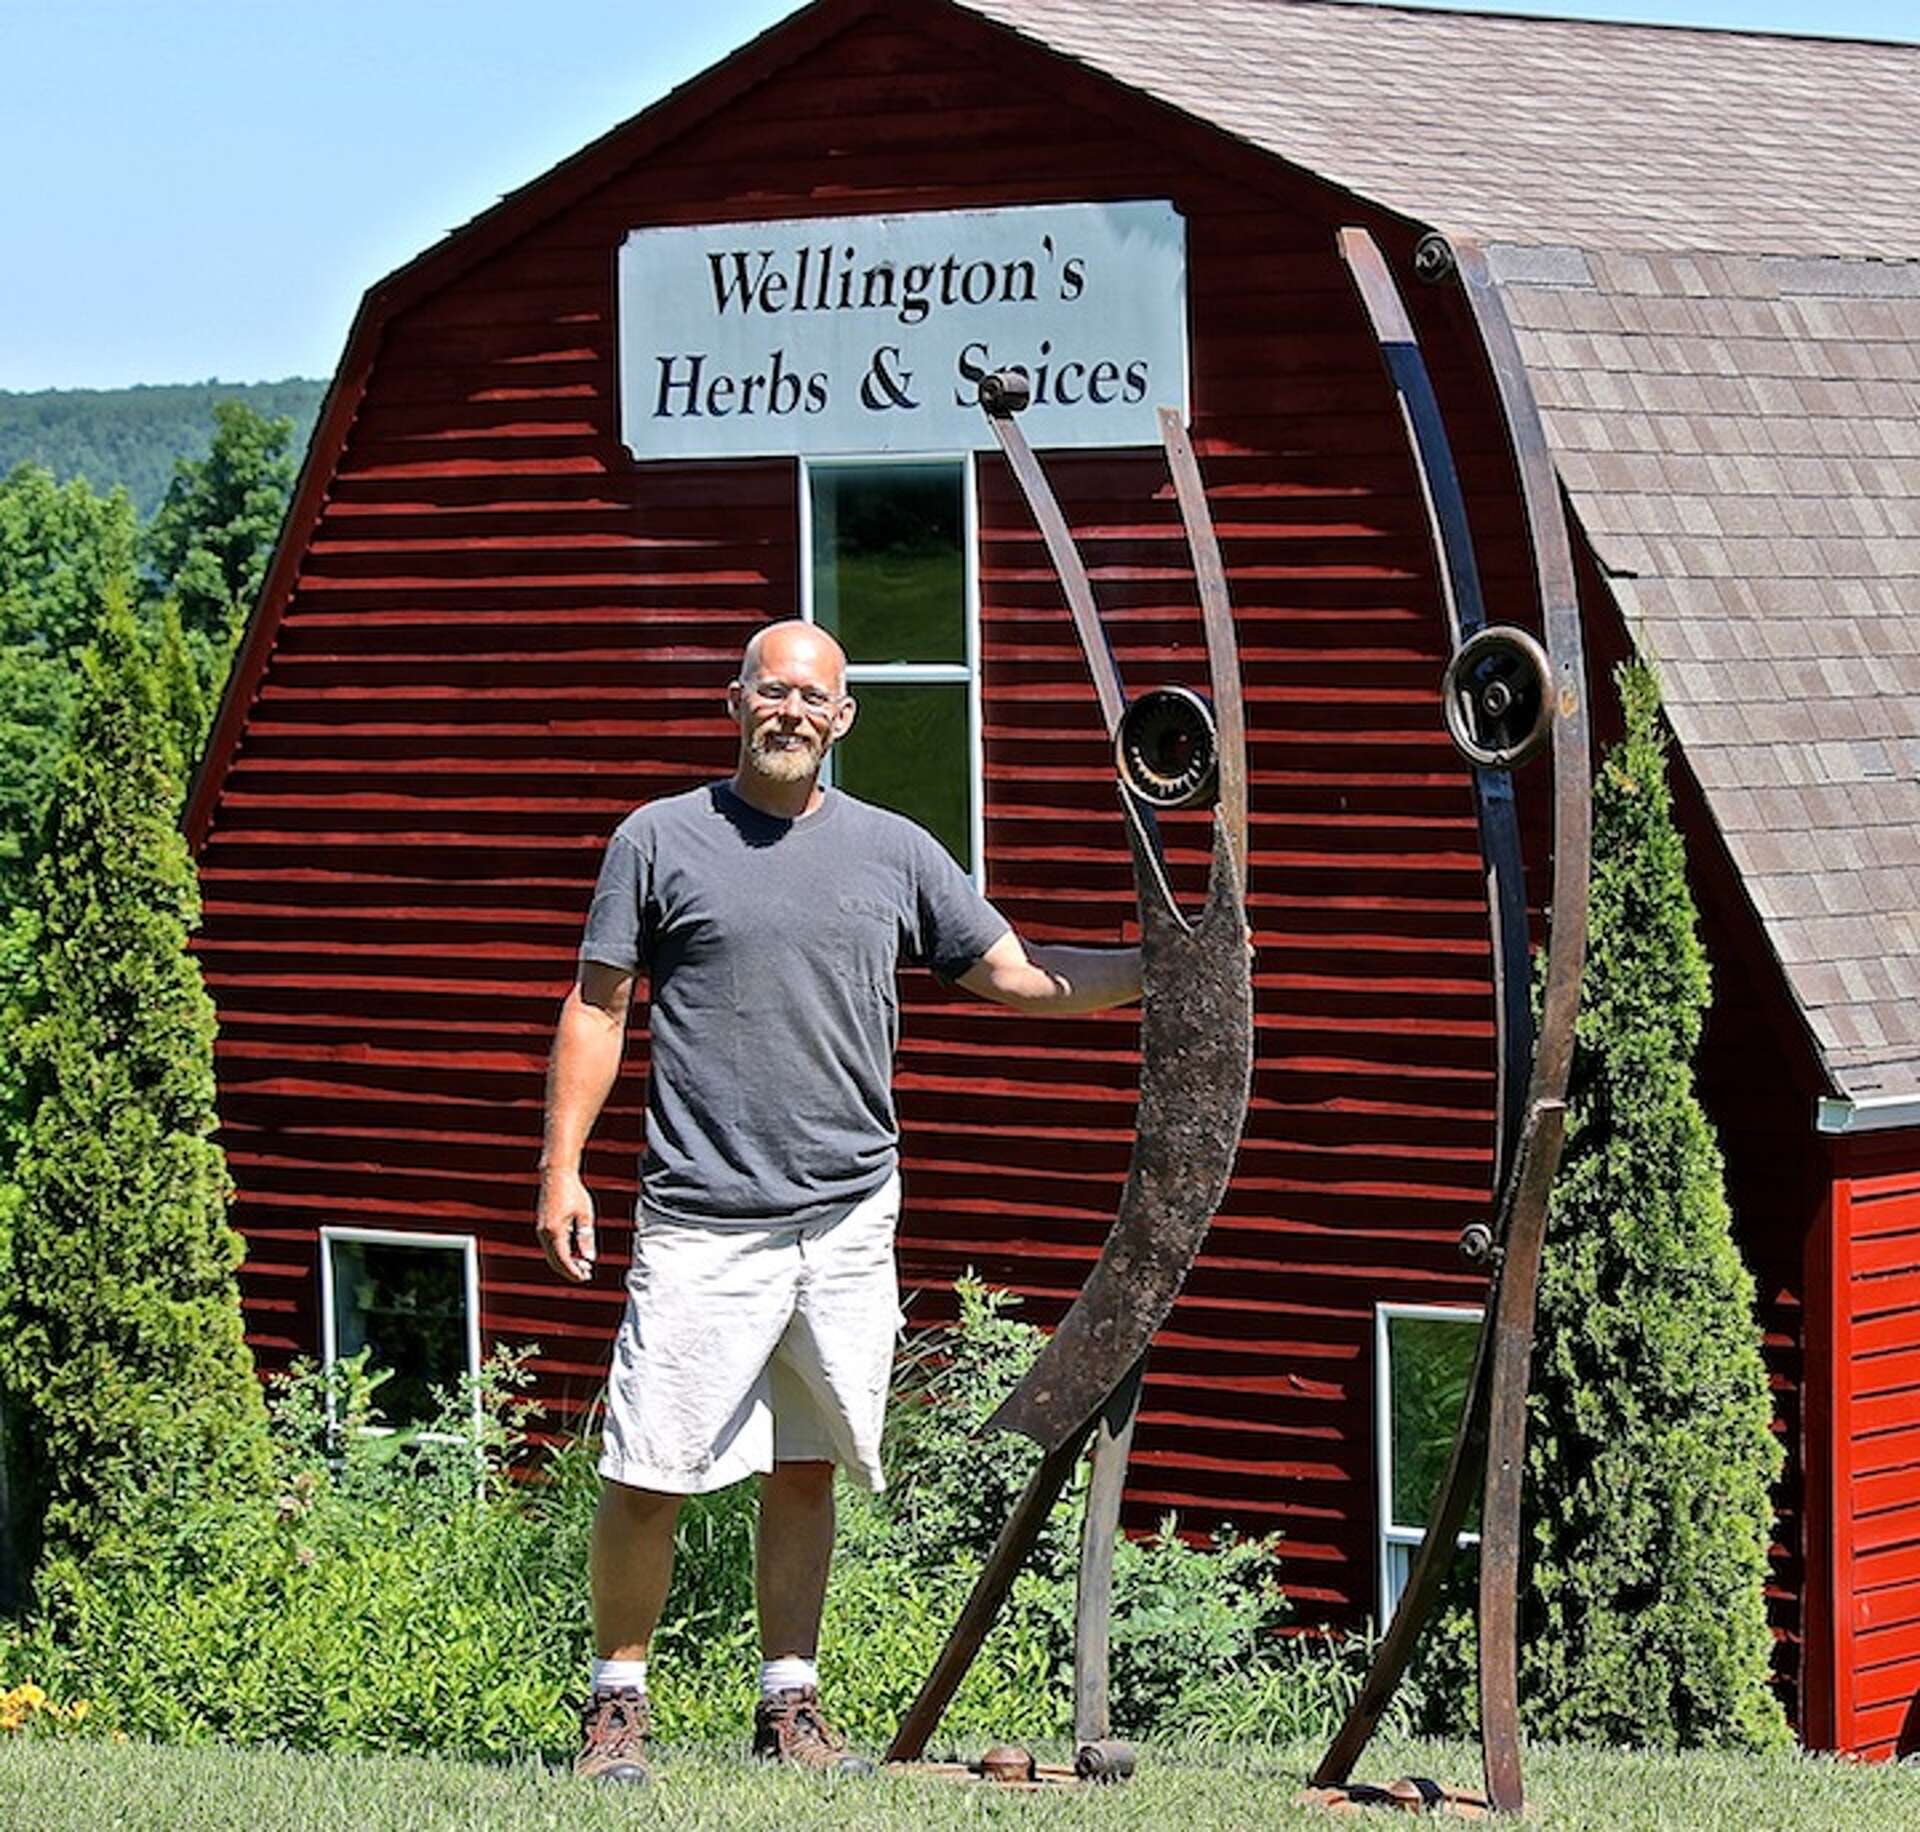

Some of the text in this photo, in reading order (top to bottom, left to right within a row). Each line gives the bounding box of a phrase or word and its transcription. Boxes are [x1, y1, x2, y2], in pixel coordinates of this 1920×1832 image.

[706, 235, 1086, 325] Wellington's
[653, 340, 1149, 418] Herbs & Sices
